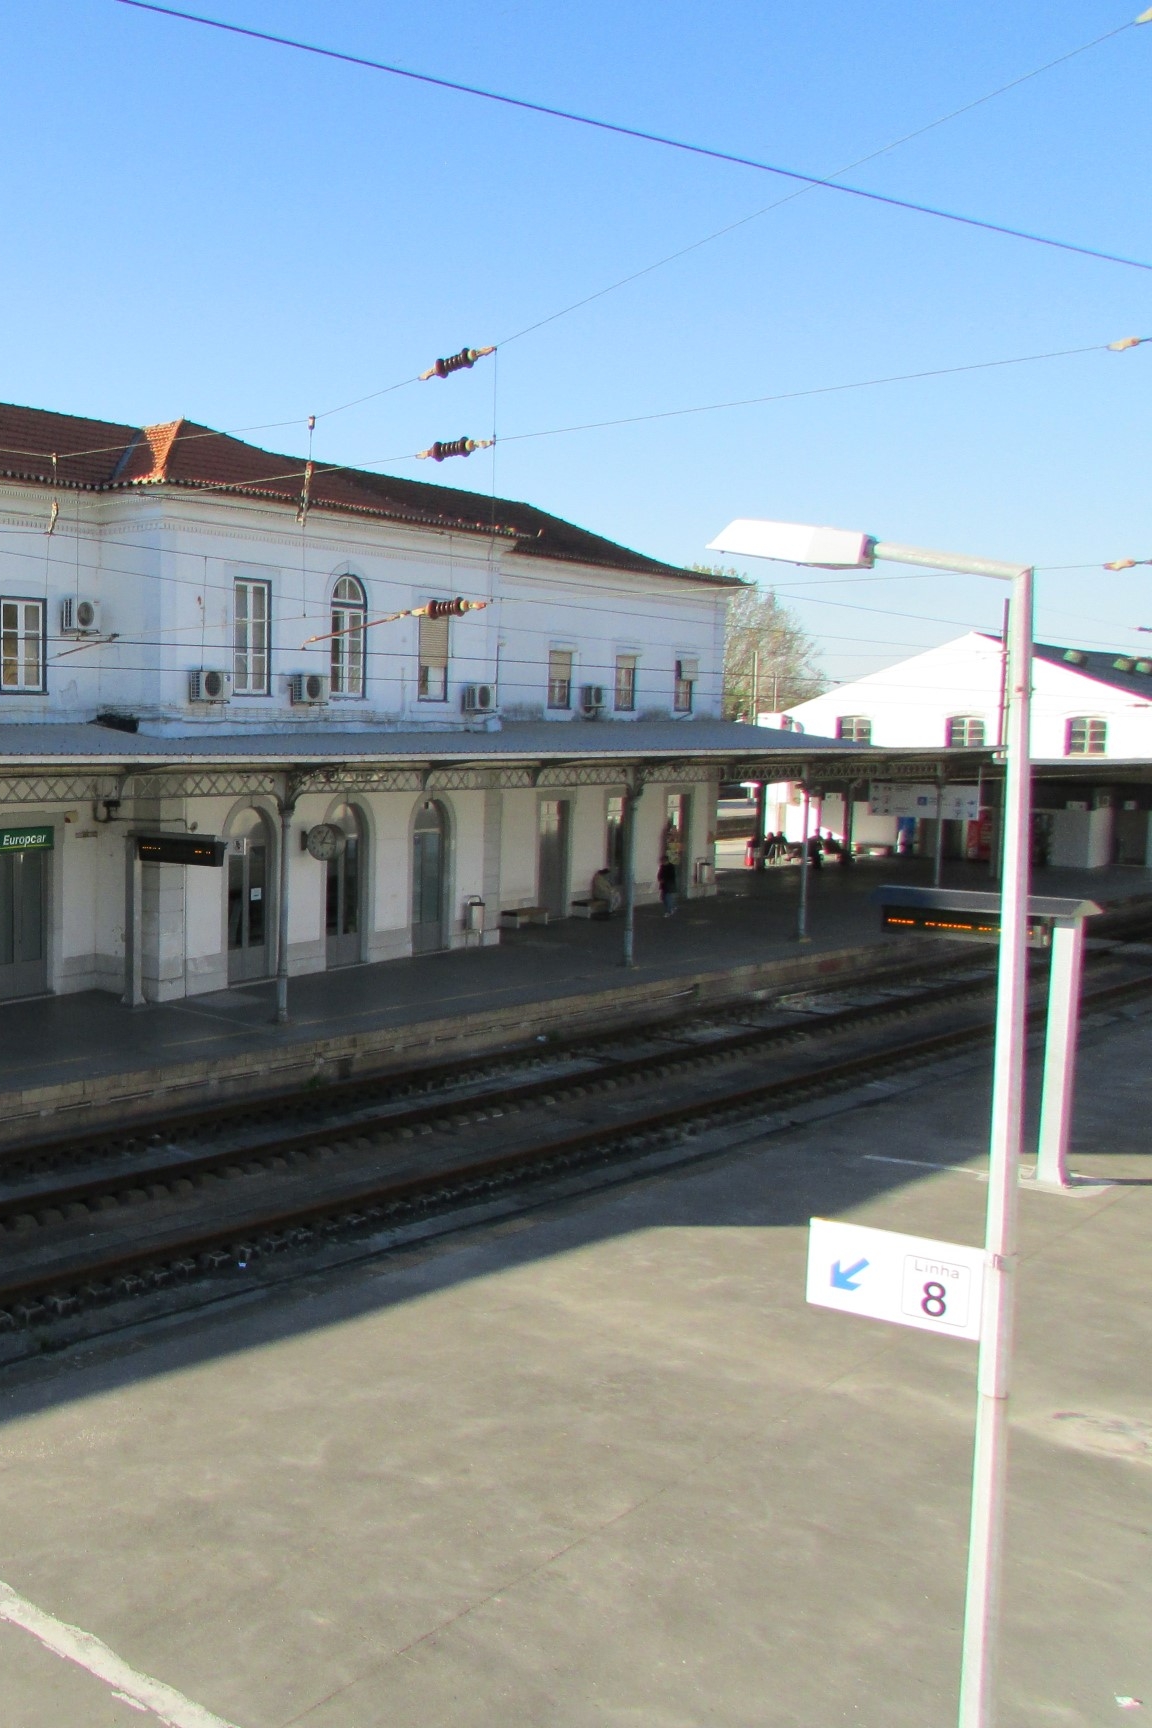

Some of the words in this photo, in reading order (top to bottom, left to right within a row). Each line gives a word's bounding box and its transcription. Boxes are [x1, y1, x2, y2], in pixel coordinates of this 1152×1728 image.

[3, 834, 46, 847] Europcar
[914, 1259, 959, 1279] Linha
[921, 1281, 946, 1317] 8
